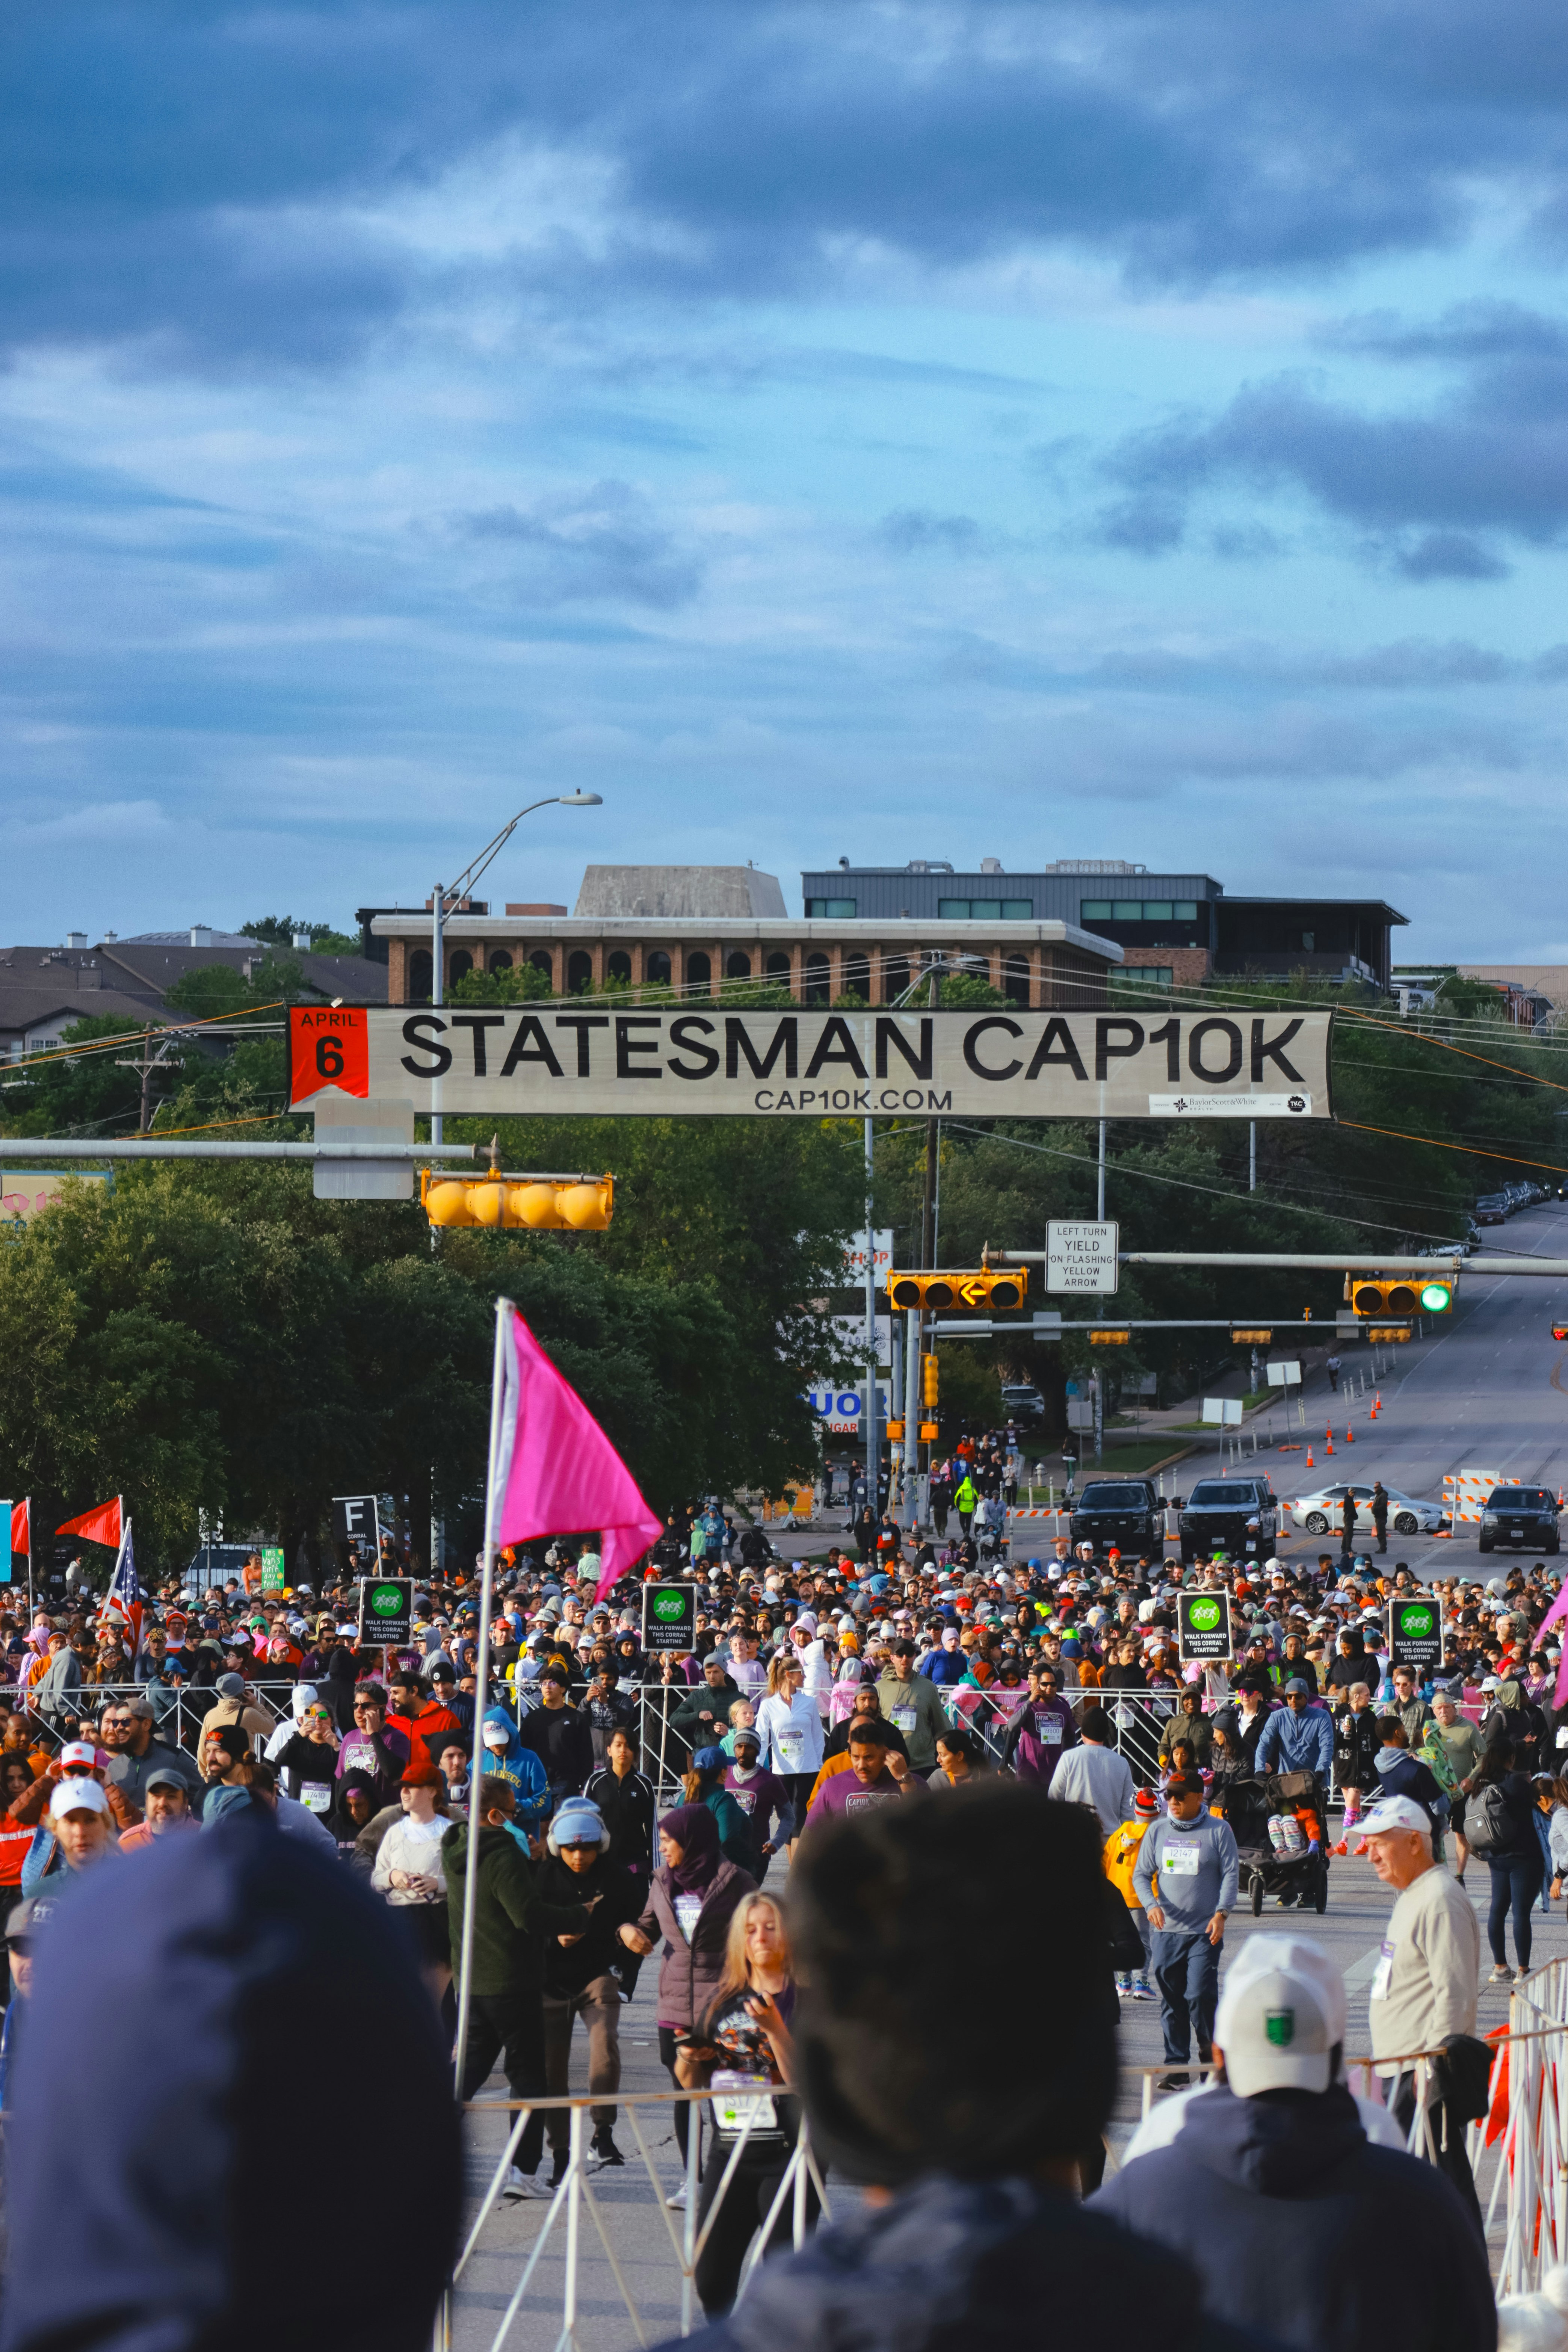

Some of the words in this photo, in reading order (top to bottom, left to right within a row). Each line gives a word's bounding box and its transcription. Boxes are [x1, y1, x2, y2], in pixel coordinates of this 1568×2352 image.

[301, 1013, 357, 1027] APRIL
[316, 1036, 344, 1078] 6
[400, 1015, 933, 1080] STATESMAN
[963, 1017, 1306, 1083] CAP10K
[755, 1089, 952, 1110] CAP10K.COM
[1065, 1241, 1099, 1251] YIELD
[1067, 1255, 1112, 1264] FLASHING
[345, 1502, 364, 1531] F
[1170, 1849, 1193, 1858] 12147
